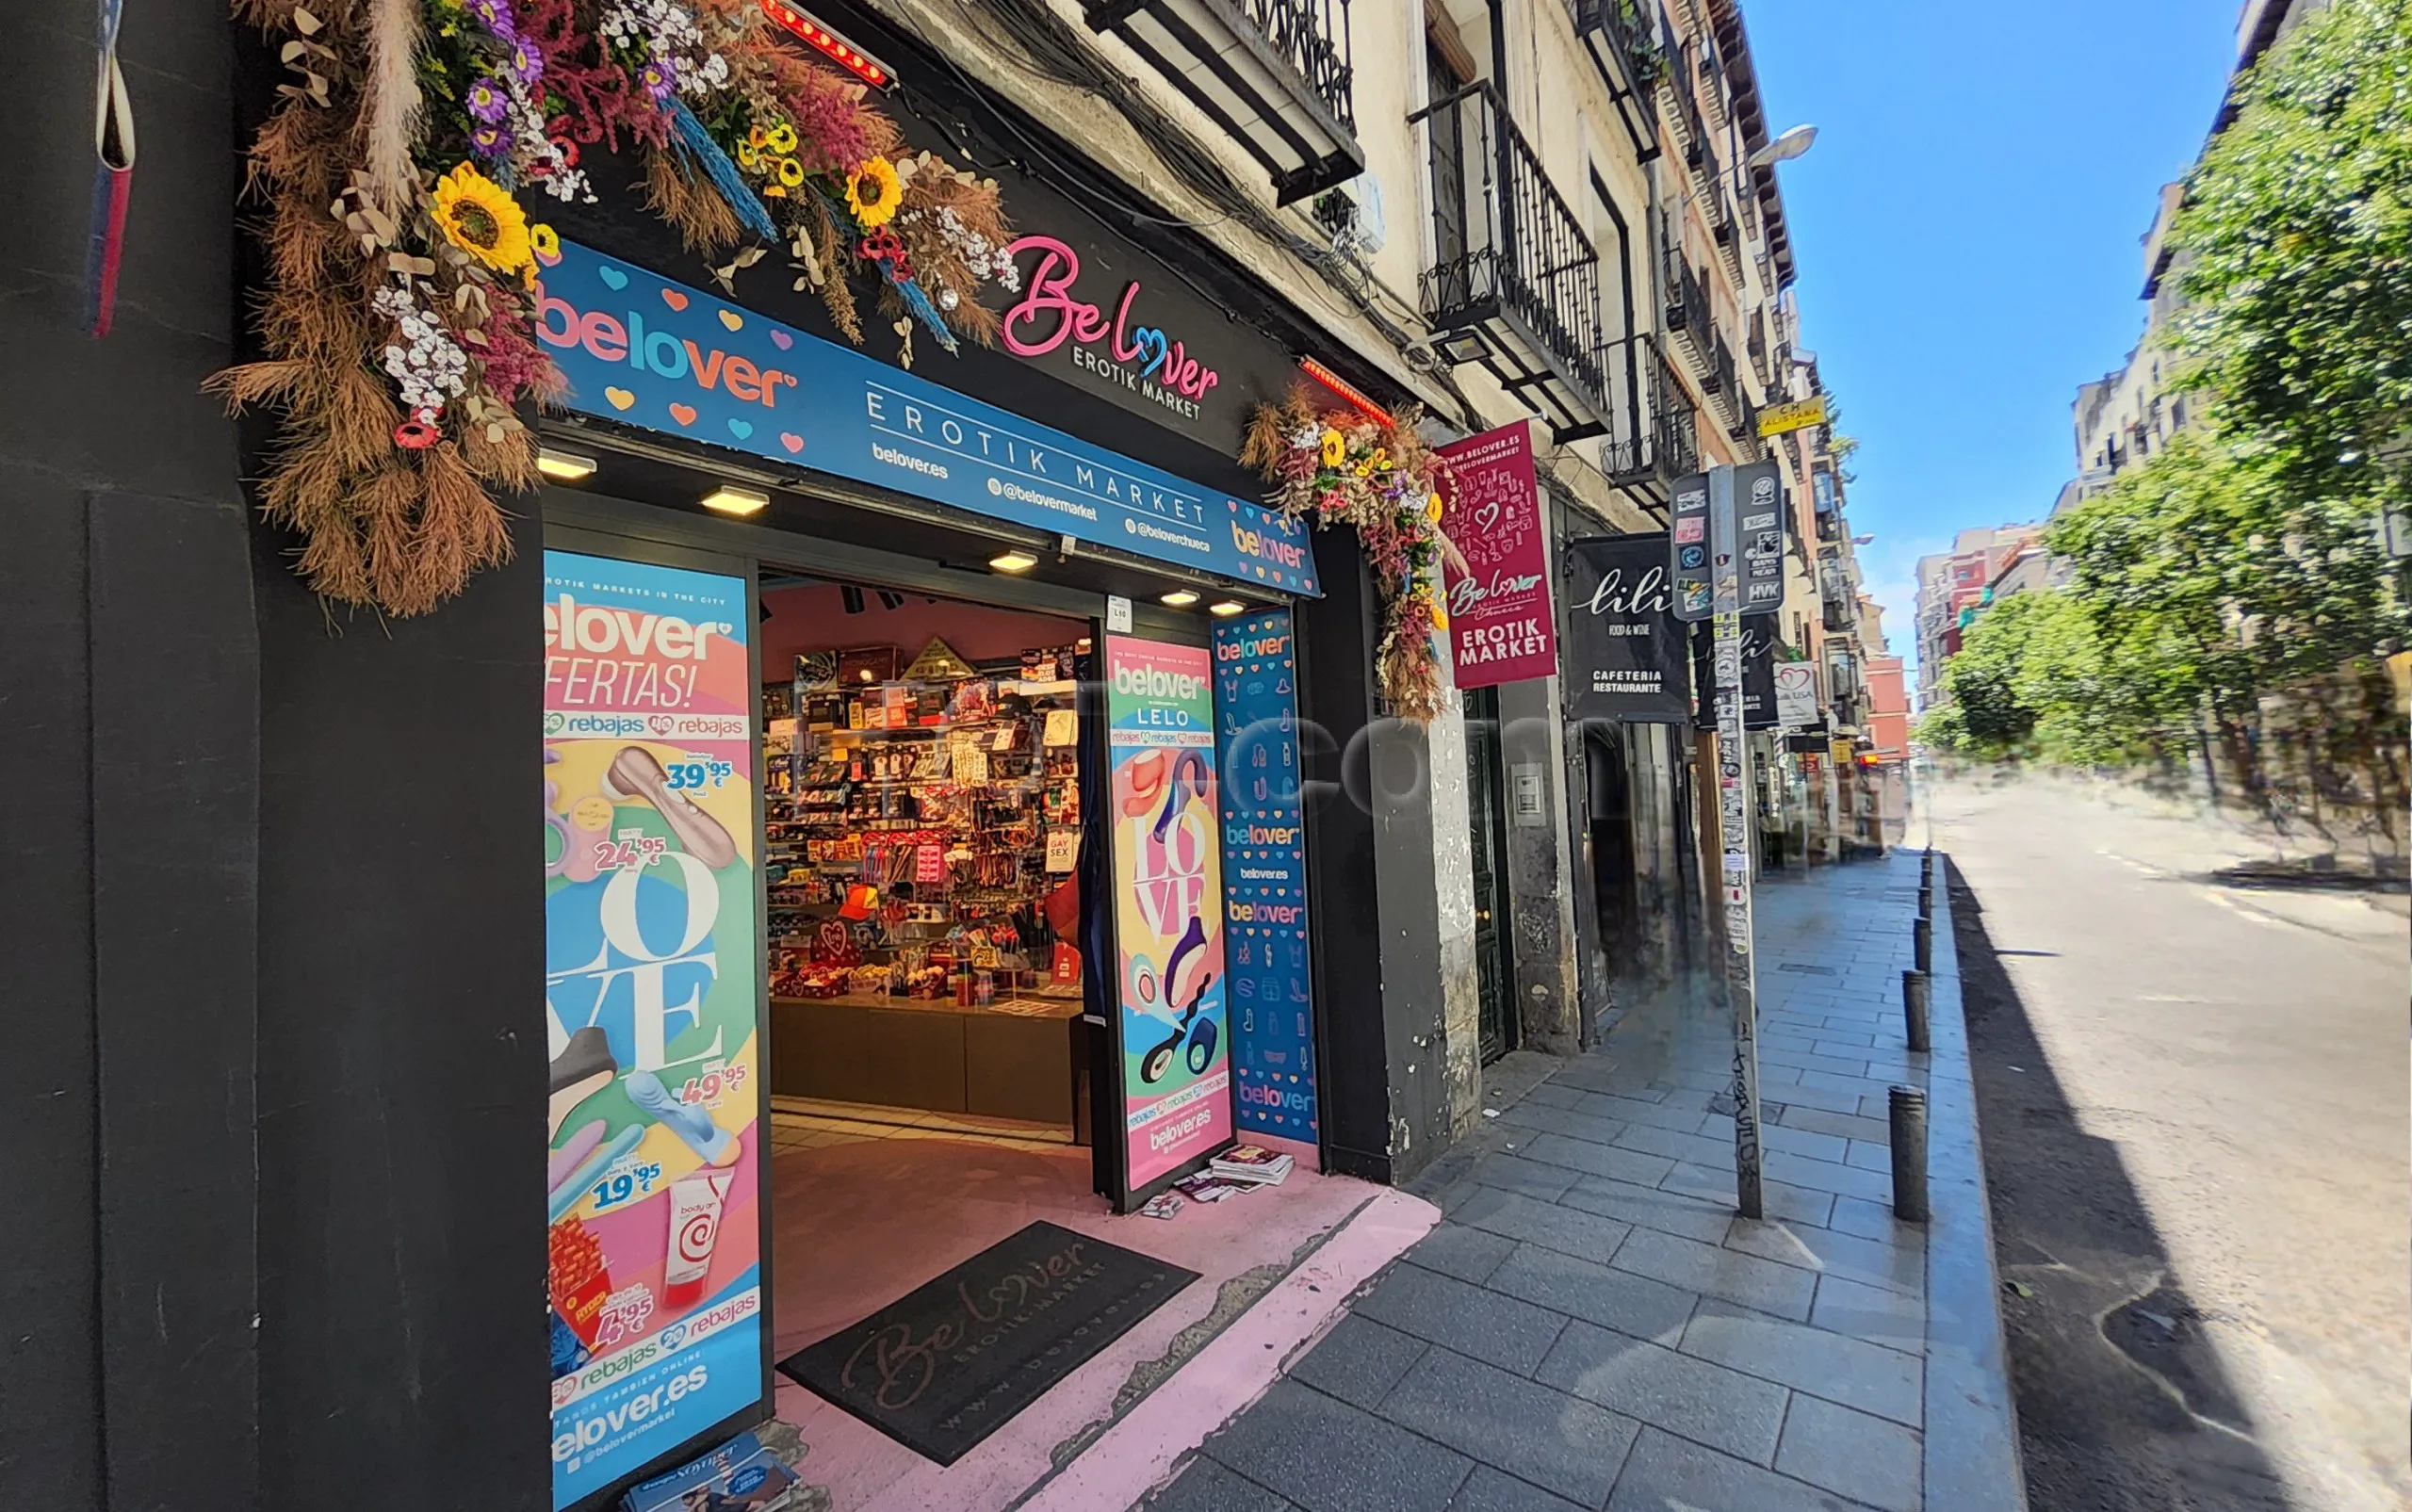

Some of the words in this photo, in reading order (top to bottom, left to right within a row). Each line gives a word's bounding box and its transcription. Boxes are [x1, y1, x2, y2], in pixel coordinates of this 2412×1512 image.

[536, 280, 784, 407] belover
[1073, 346, 1136, 391] EROTIK
[1143, 381, 1200, 420] MARKET
[866, 392, 1046, 473] EROTIK
[1077, 465, 1205, 524] MARKET
[872, 442, 949, 479] belover.es
[1003, 482, 1098, 521] @belovermarket
[1138, 524, 1211, 553] @beloverchueca
[1230, 520, 1305, 569] belover
[593, 583, 649, 596] MARKETS
[675, 593, 694, 602] THE
[700, 596, 725, 606] CITY
[1571, 565, 1673, 615] lili
[545, 593, 717, 659] elover
[1462, 618, 1540, 648] EROTIK
[1608, 625, 1624, 636] FOOD
[1625, 625, 1632, 636] &
[1633, 624, 1650, 636] WINE
[1216, 635, 1284, 662] belover
[1459, 635, 1547, 666] MARKET
[1115, 659, 1199, 700] belover
[1593, 671, 1662, 681] CAFETERIA
[1593, 683, 1662, 693] RESTAURANTE
[568, 715, 644, 737] rebajas
[678, 718, 742, 737] rebajas
[1137, 707, 1189, 726] LELO
[1051, 839, 1068, 848] GAY
[1226, 824, 1295, 845] belover
[1050, 848, 1068, 857] SEX
[1240, 868, 1289, 880] belover.es
[1229, 901, 1298, 924] belover
[1239, 1081, 1312, 1112] belover
[1150, 1109, 1212, 1150] belover.es
[680, 1204, 705, 1214] body
[580, 1342, 657, 1390] rebajas
[691, 1295, 755, 1337] rebajas
[552, 1364, 708, 1462] elover.es
[584, 1408, 676, 1463] @belovermarket
